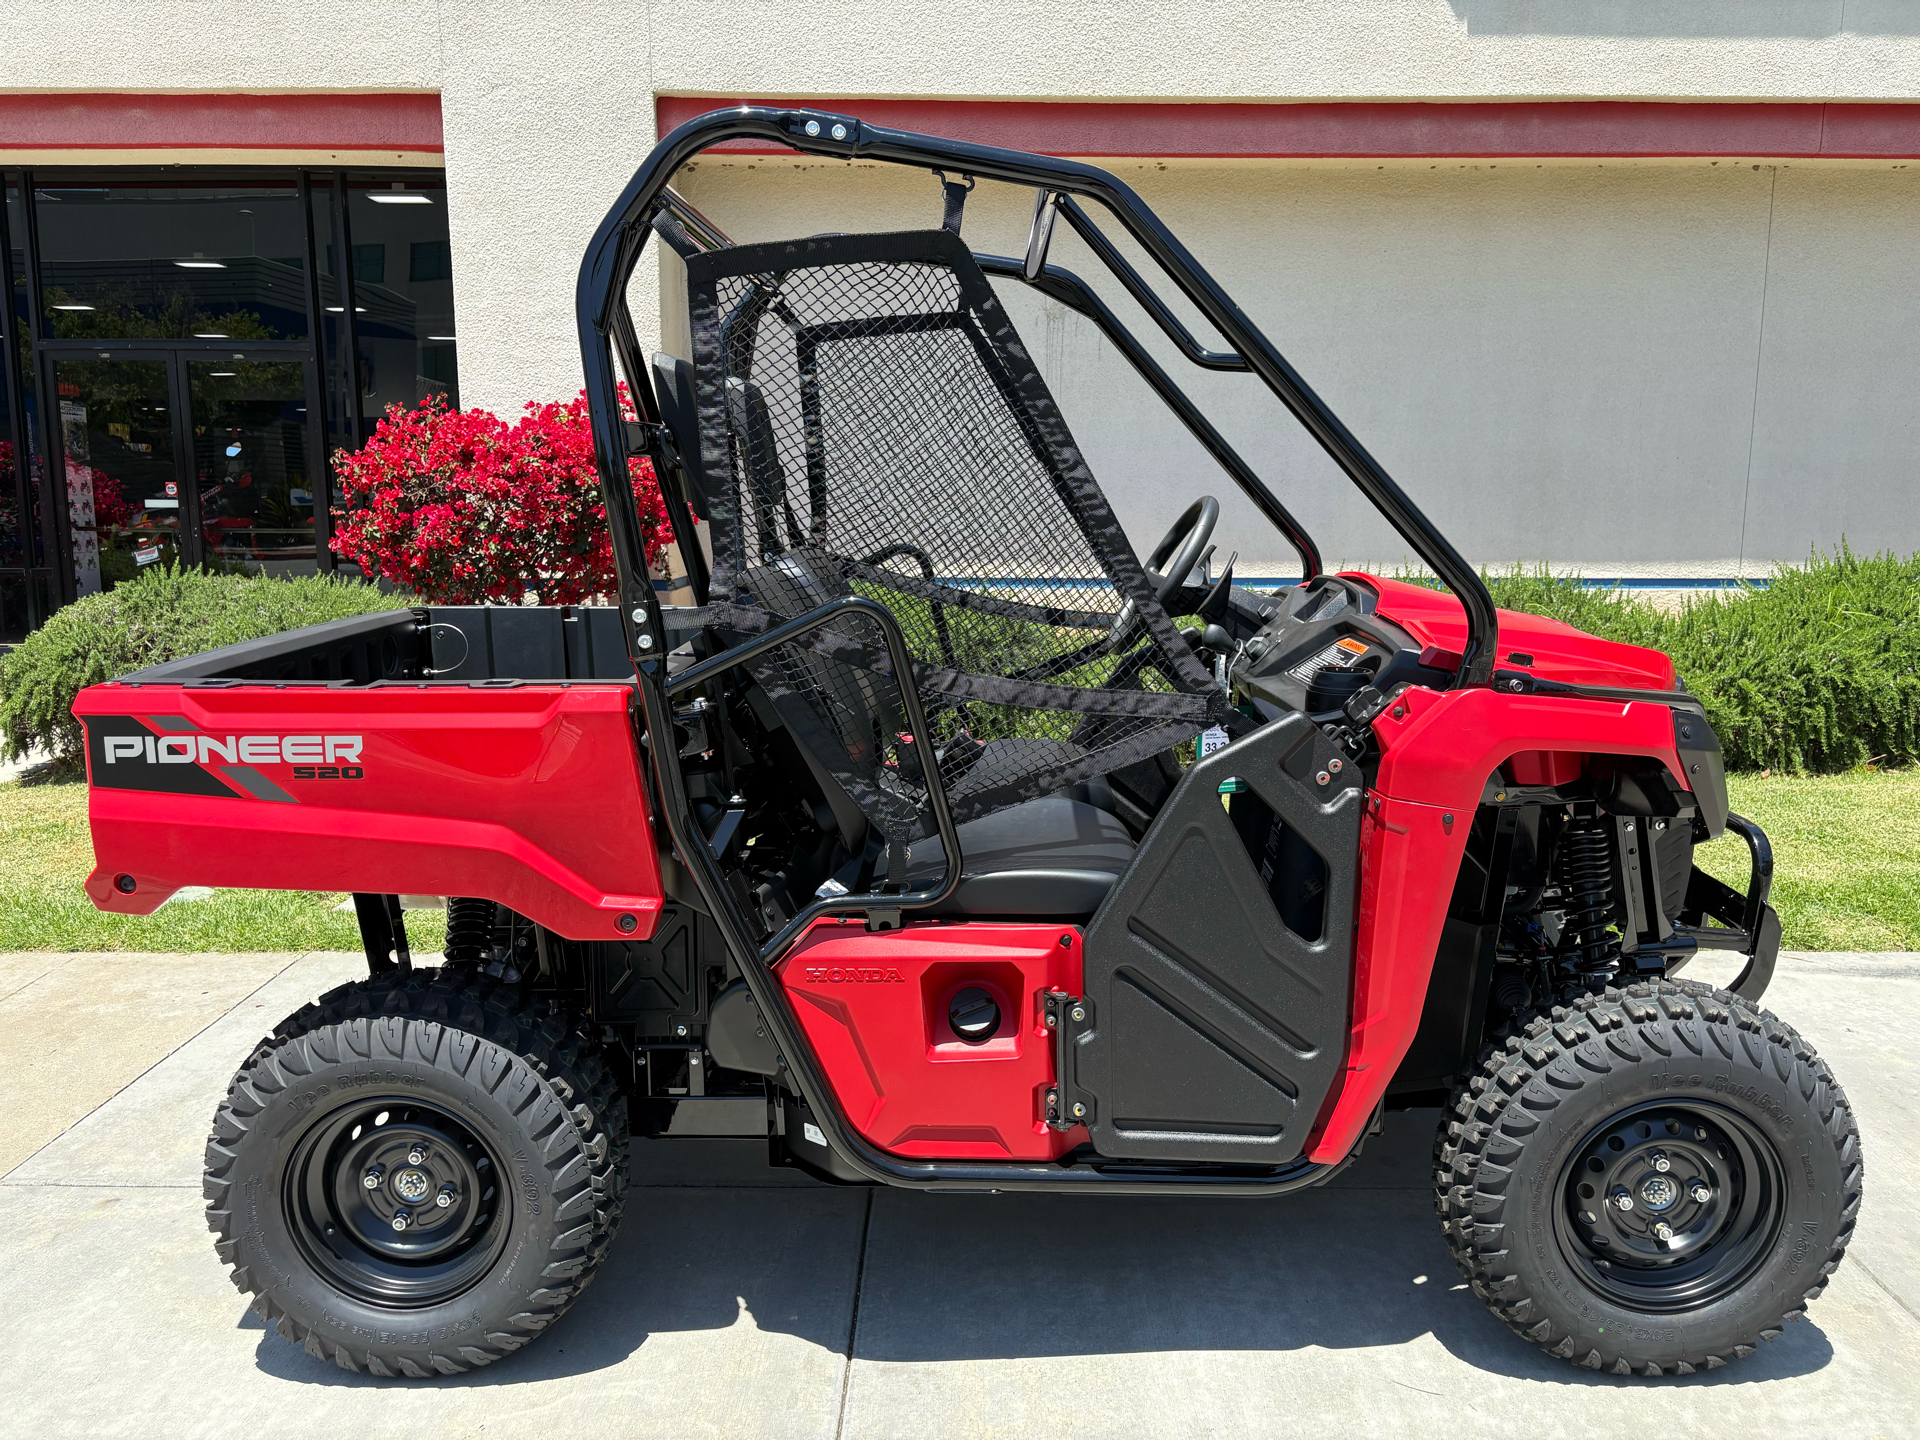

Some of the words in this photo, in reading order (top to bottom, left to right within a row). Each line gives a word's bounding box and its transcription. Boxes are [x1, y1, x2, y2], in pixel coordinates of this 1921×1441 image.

[103, 735, 364, 764] PIONEER
[293, 766, 364, 779] 520
[806, 967, 905, 983] HONDA
[288, 1083, 330, 1112] Vee
[338, 1072, 426, 1090] Rubber
[1651, 1072, 1702, 1090] Vee
[1708, 1073, 1795, 1126] Rubber
[512, 1149, 542, 1216] V-392
[1783, 1221, 1818, 1275] V-392
